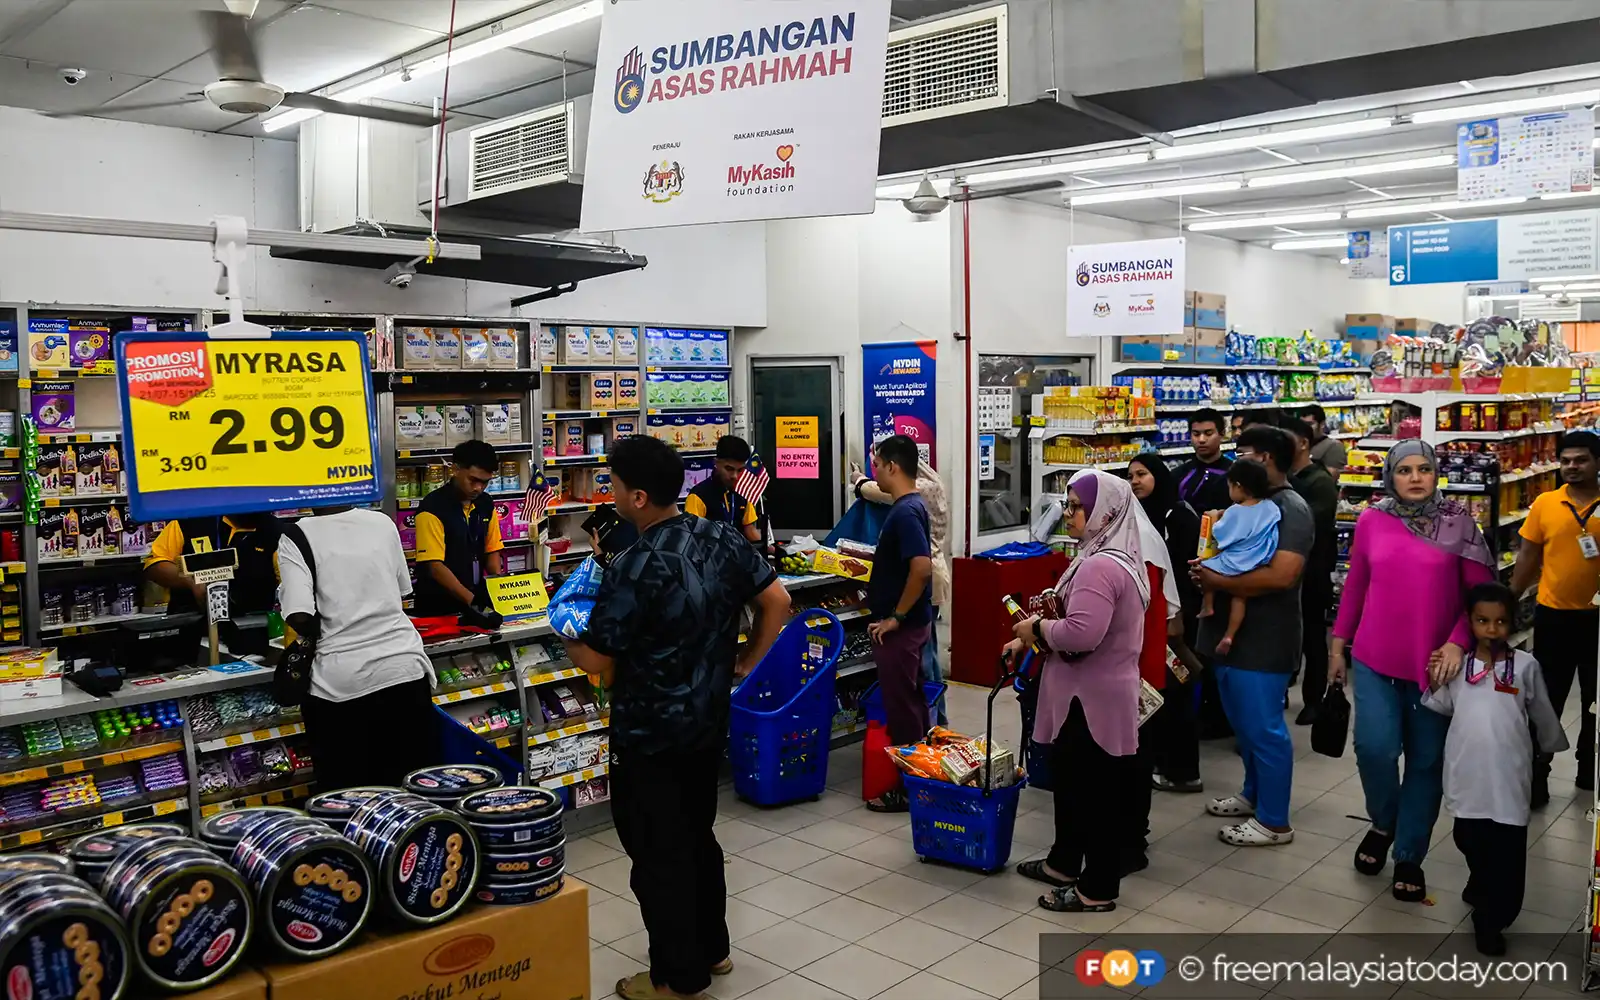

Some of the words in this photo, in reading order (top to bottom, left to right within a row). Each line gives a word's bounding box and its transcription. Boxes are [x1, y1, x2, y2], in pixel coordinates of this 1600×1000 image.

[650, 12, 855, 74] SUMBANGAN
[647, 69, 715, 103] ASAS
[720, 46, 852, 91] RAHMAH
[733, 131, 755, 141] RAKAN
[756, 128, 794, 138] KERJASAMA
[652, 141, 681, 151] PENERAJU
[727, 162, 795, 187] MyKasih
[726, 183, 795, 197] foundation
[1092, 258, 1172, 274] SUMBANGAN
[1092, 274, 1120, 284] ASAS
[1123, 271, 1172, 282] RAHMAH
[1392, 270, 1405, 282] G
[1128, 304, 1154, 313] MyKasih
[215, 352, 346, 374] MYRASA
[893, 358, 920, 368] MYDIN
[127, 366, 199, 383] PROMOTION
[169, 410, 190, 421] RM
[209, 406, 344, 456] 2.99
[344, 448, 366, 456] EACH
[37, 448, 68, 463] PediaSu
[79, 446, 110, 462] PediaSu
[142, 449, 159, 458] RM
[160, 455, 208, 474] 3.90
[328, 464, 373, 479] MYDIN
[196, 540, 204, 552] 7
[499, 580, 530, 590] MYKASIH
[497, 594, 519, 602] BOLEH
[519, 590, 541, 599] BAYAR
[1029, 594, 1043, 609] FIRE
[934, 820, 965, 833] MYDIN
[402, 846, 418, 877] MYRASA
[408, 872, 423, 905] Biskut
[418, 826, 437, 870] Mentega
[459, 957, 531, 994] Mentega
